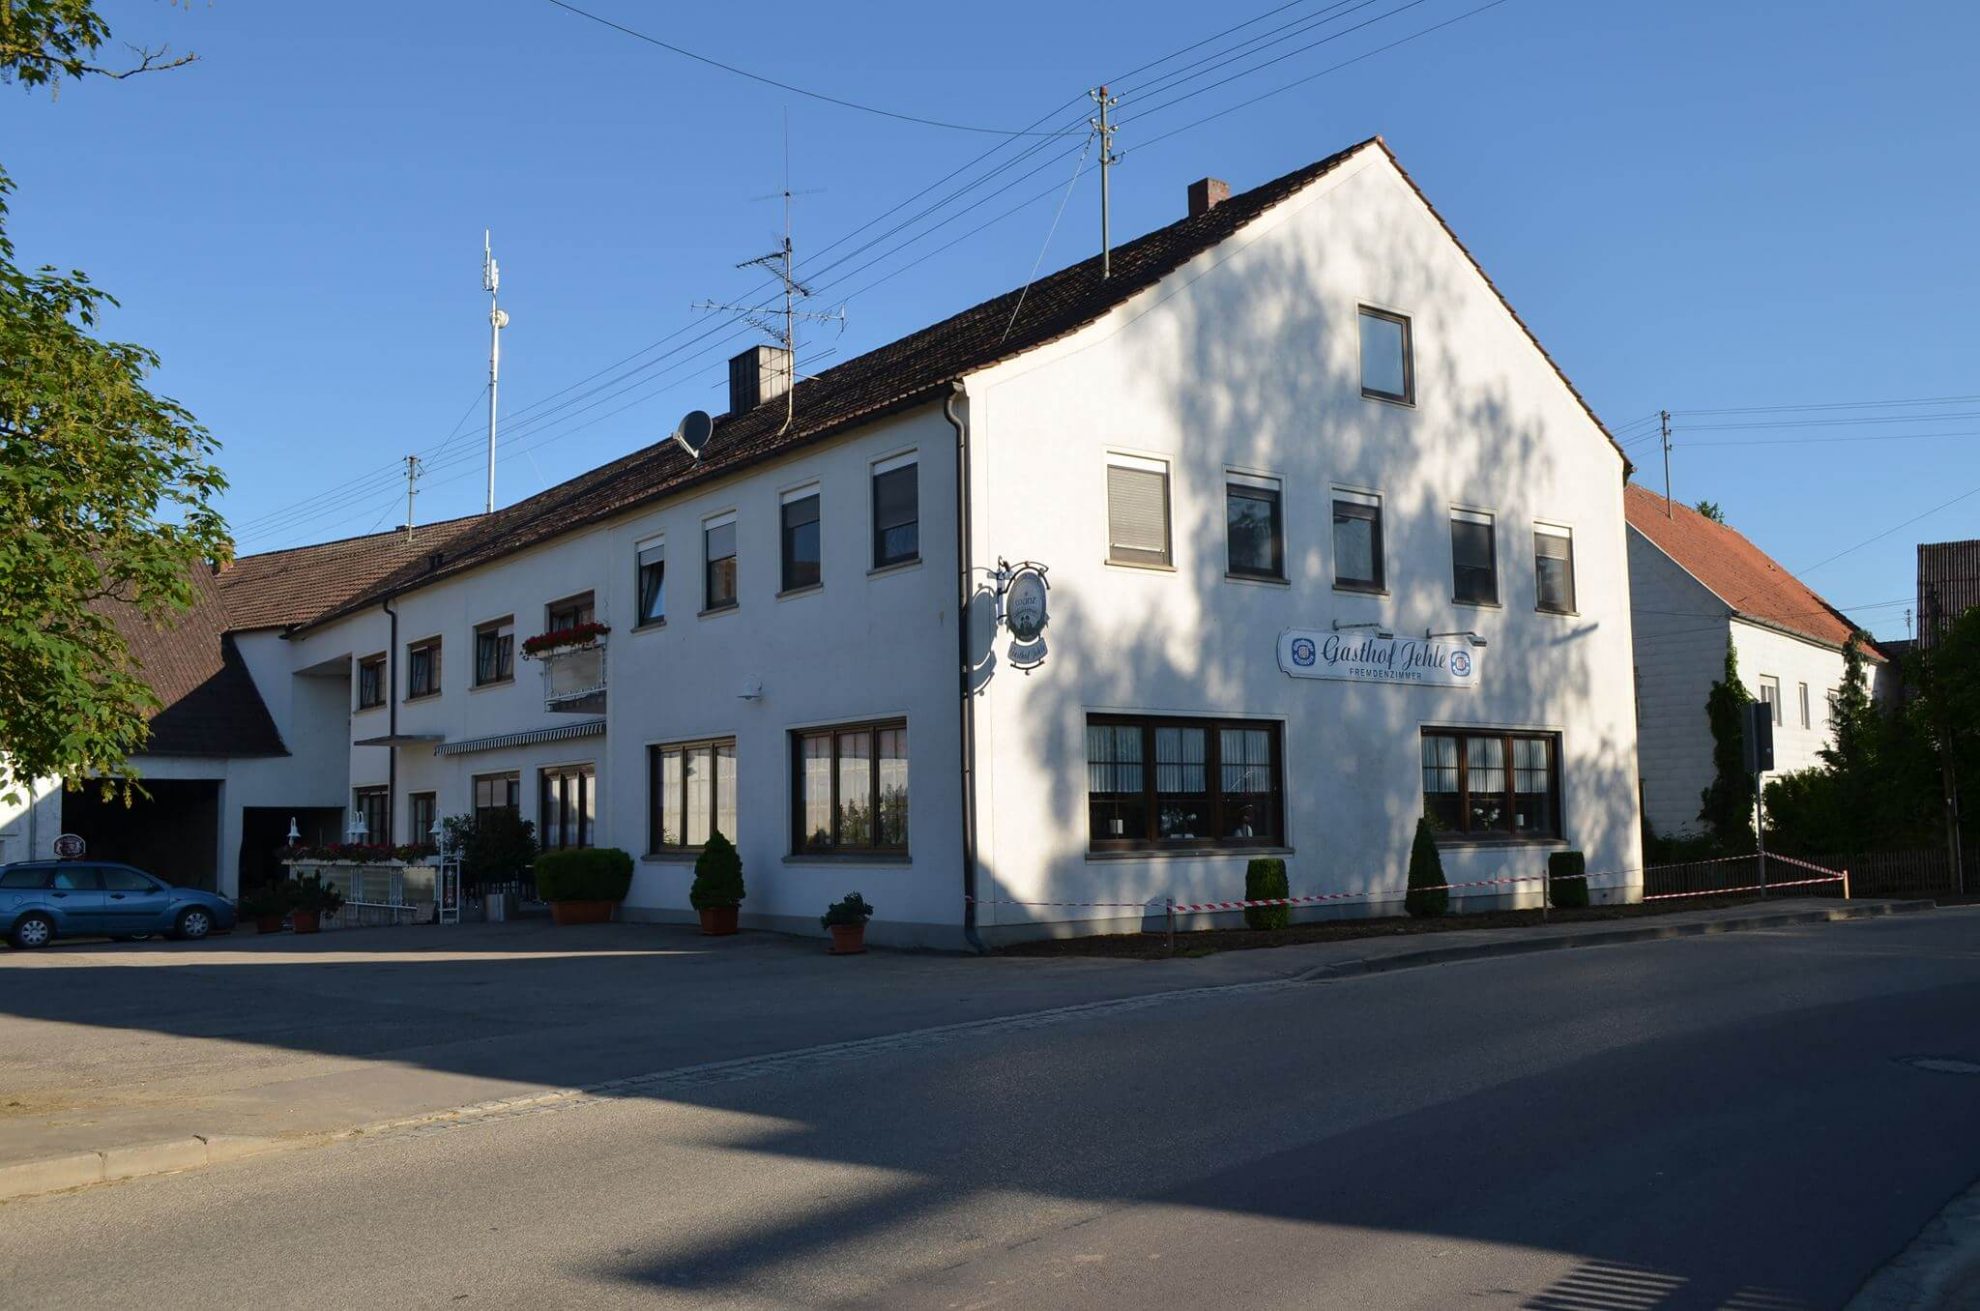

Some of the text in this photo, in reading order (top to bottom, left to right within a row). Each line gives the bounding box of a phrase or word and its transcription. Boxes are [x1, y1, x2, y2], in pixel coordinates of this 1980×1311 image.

[1321, 635, 1396, 670] Gasthof
[1400, 641, 1446, 671] Jehle
[1349, 667, 1422, 681] FREMDENZIMMER
